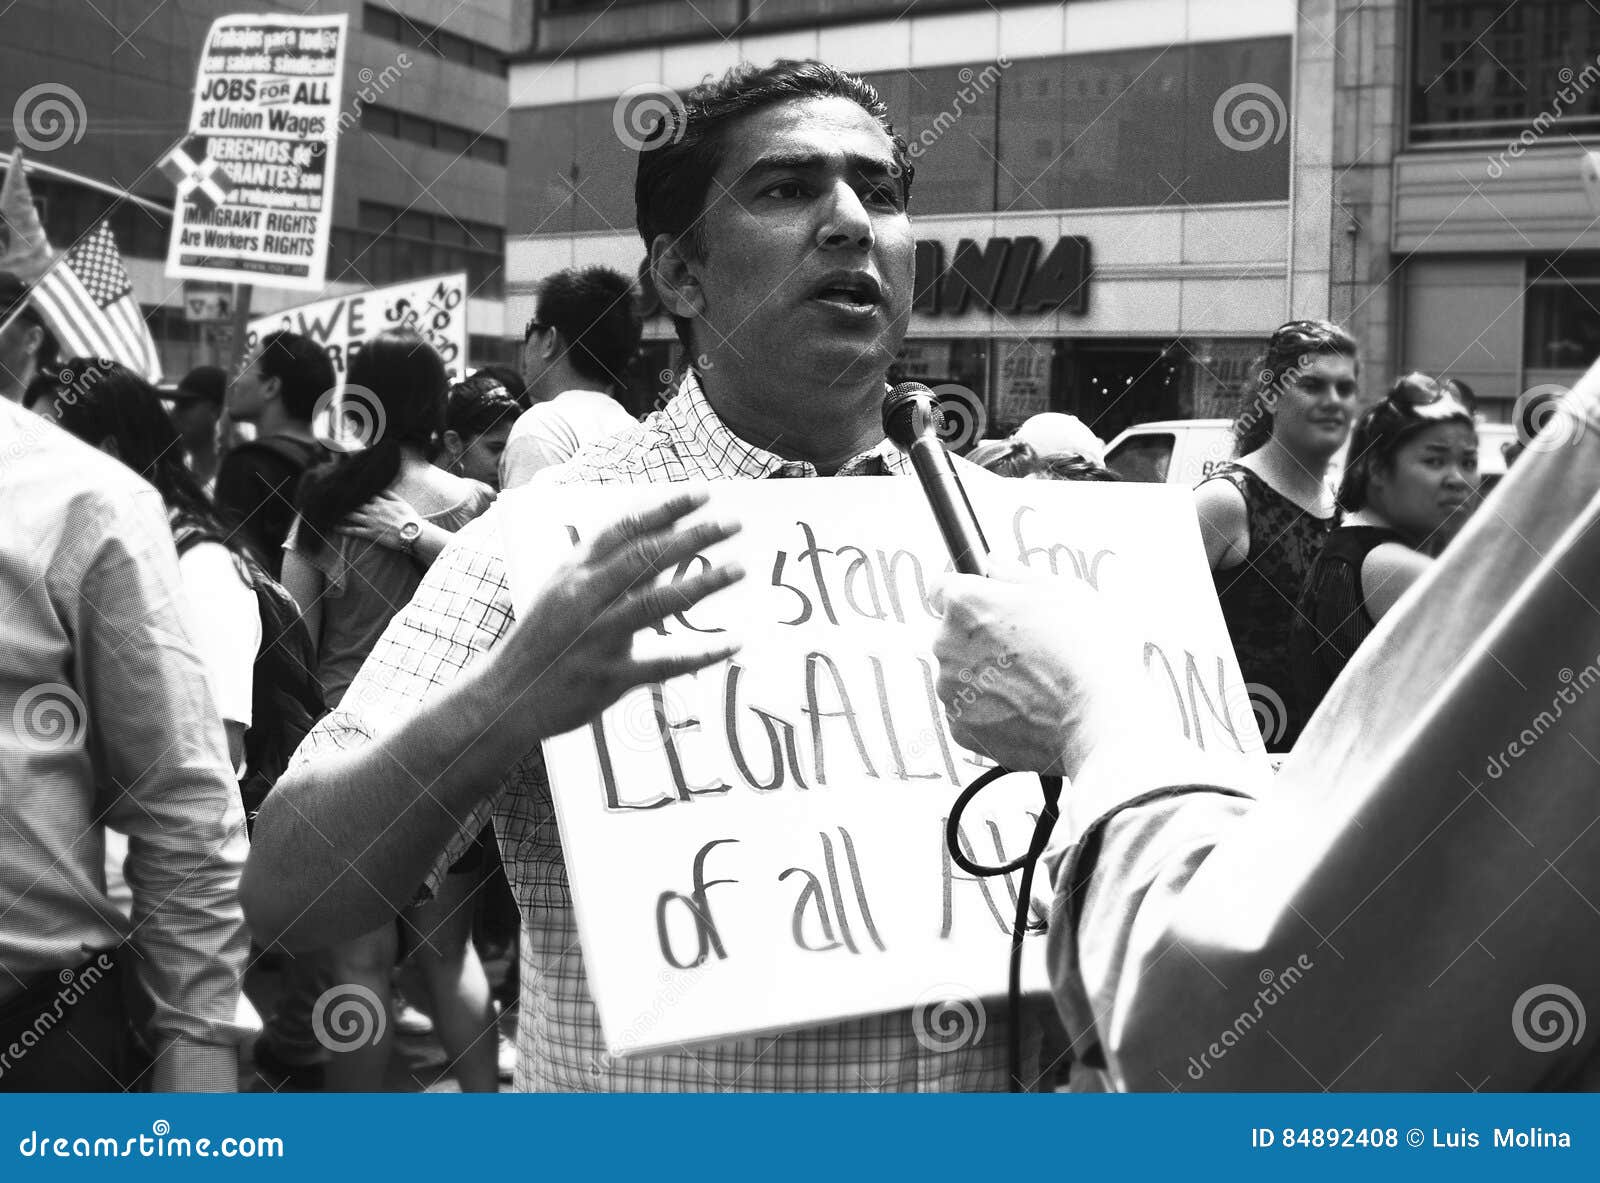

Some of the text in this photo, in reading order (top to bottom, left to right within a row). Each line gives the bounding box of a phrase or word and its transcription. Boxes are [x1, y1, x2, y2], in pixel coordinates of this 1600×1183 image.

[200, 78, 331, 105] JOBS FOR ALL
[200, 108, 326, 138] at Union Wages
[207, 137, 291, 164] DERECHOS
[183, 207, 317, 235] IMMIGRANT RIGHTS
[180, 227, 314, 257] Are Workers RIGHTS
[297, 298, 366, 343] WE
[772, 520, 955, 627] stan
[655, 838, 741, 969] of
[777, 826, 888, 956] all
